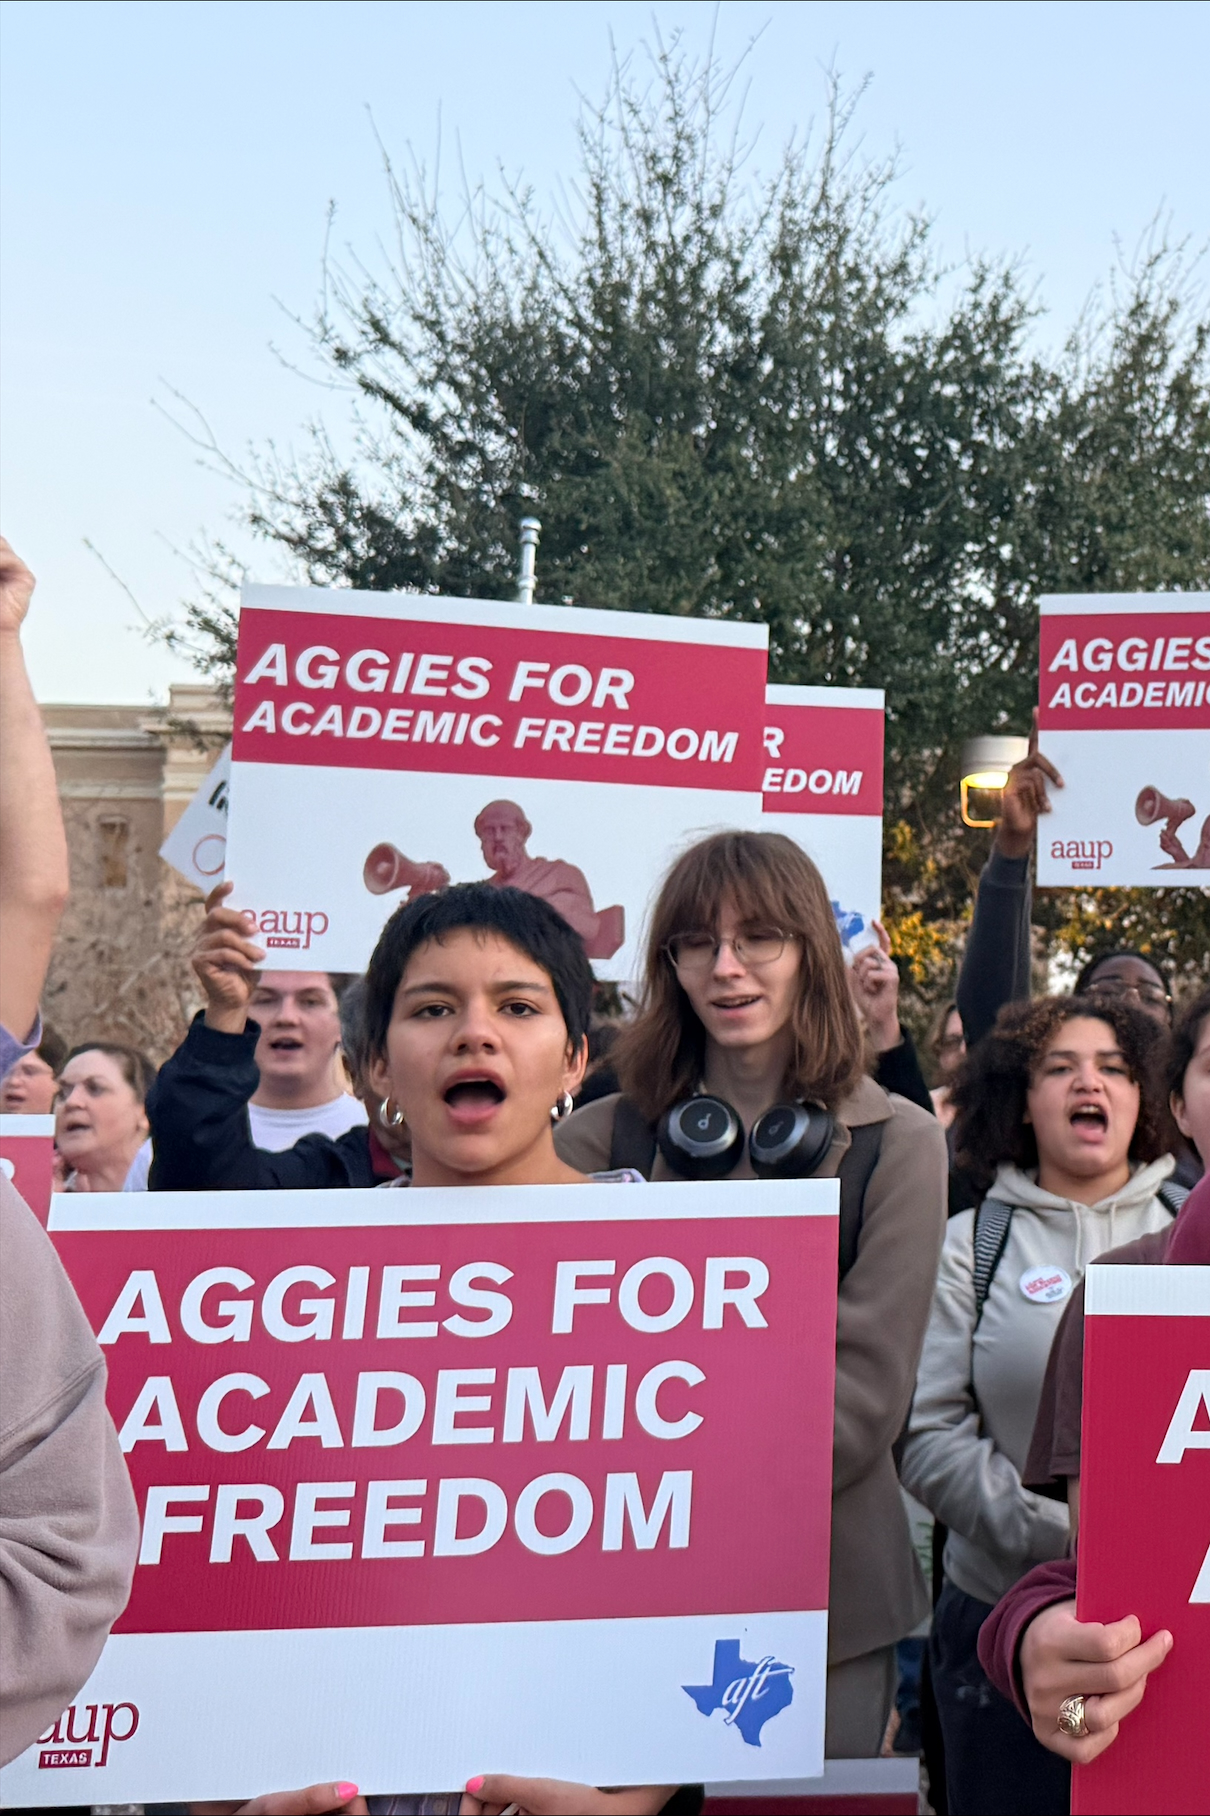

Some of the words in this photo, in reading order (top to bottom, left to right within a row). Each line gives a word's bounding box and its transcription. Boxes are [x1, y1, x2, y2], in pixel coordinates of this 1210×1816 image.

[244, 643, 493, 700] AGGIES
[508, 660, 635, 710] FOR
[242, 700, 503, 748] ACADEMIC
[513, 717, 738, 764] FREEDOM
[1051, 840, 1113, 869] aaup
[98, 1261, 513, 1346] AGGIES
[551, 1256, 771, 1335] FOR
[119, 1360, 707, 1453] ACADEMIC
[137, 1470, 694, 1567] FREEDOM
[722, 1656, 795, 1726] aft
[43, 1753, 88, 1765] TEXAS
